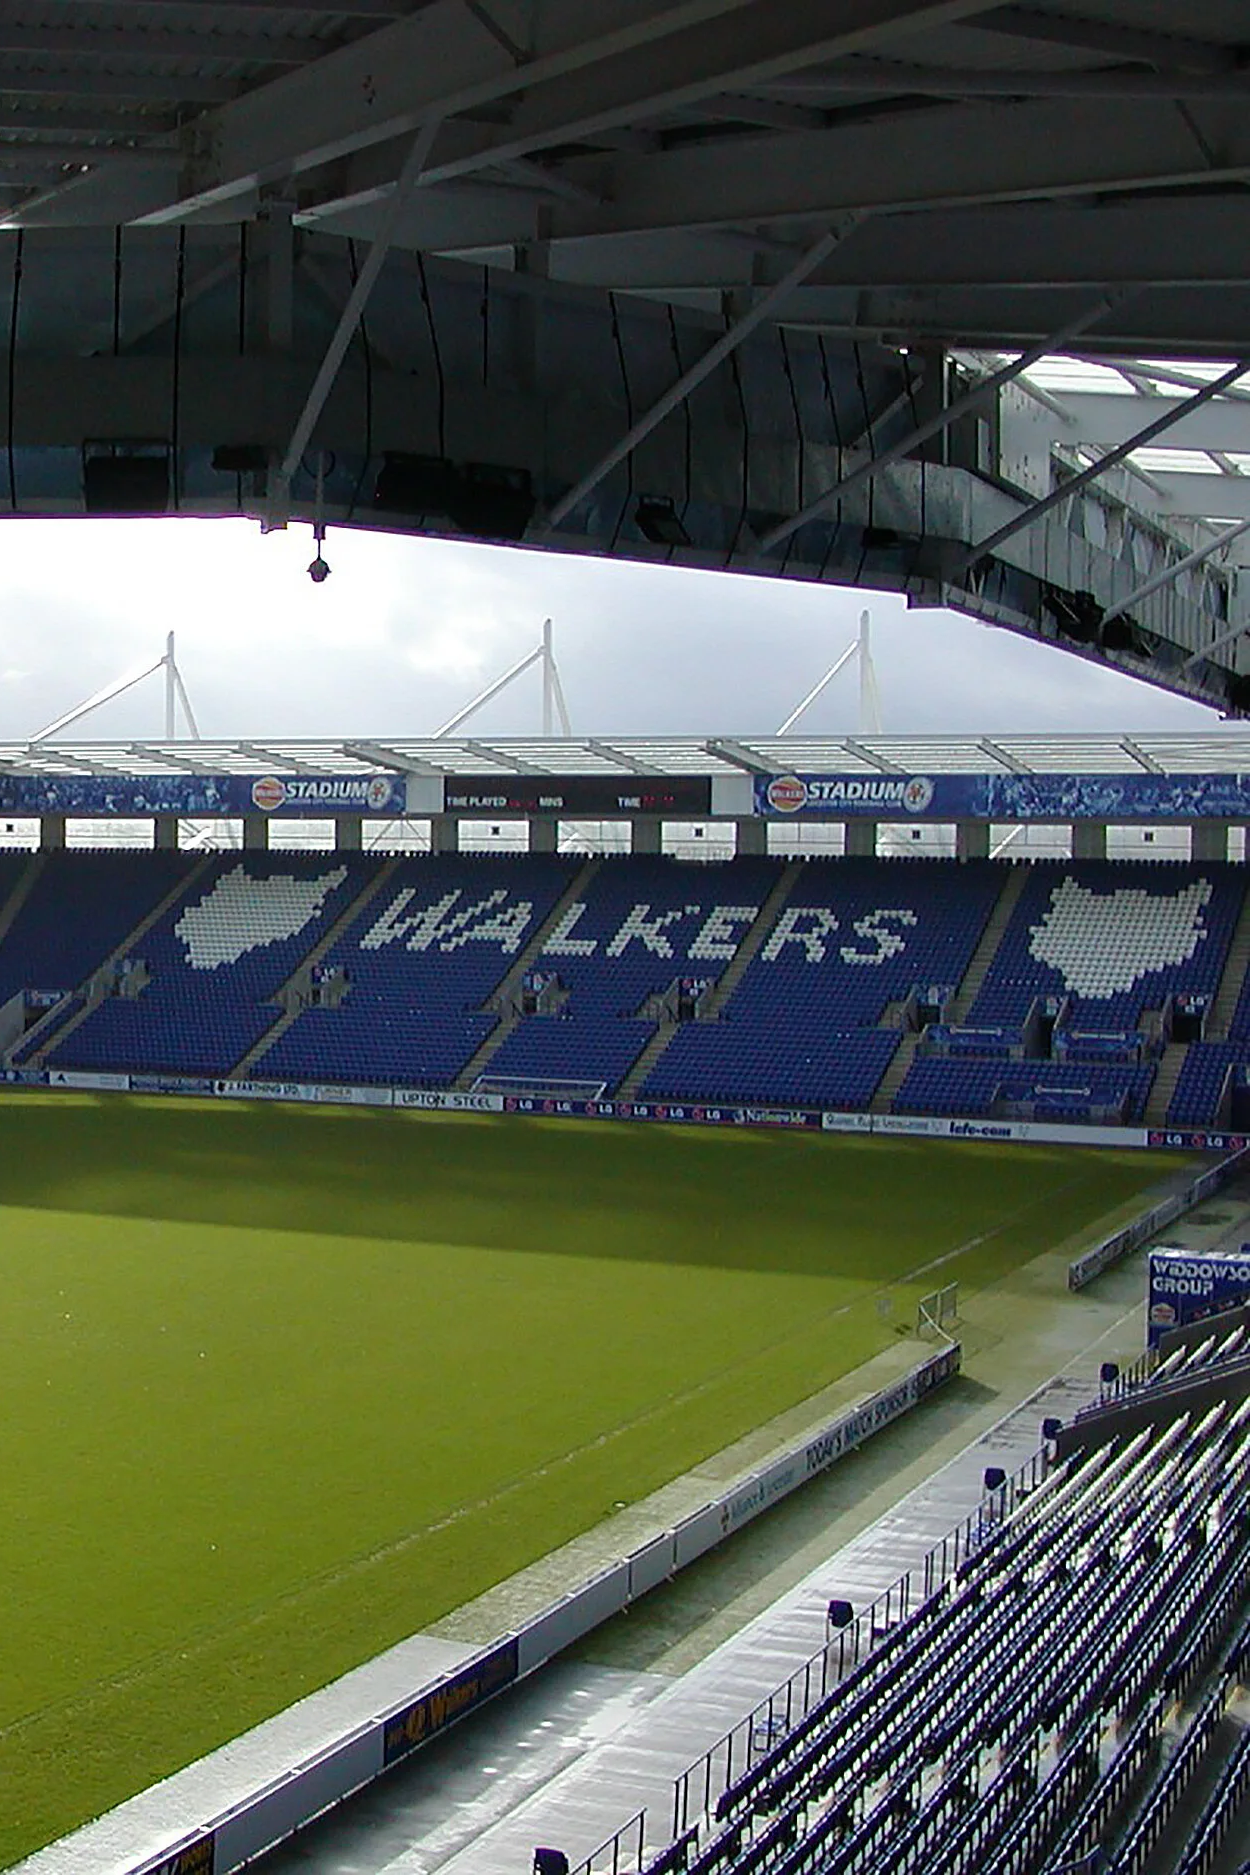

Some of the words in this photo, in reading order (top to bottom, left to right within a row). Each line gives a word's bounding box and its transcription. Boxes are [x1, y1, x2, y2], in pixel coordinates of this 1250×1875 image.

[286, 781, 369, 798] STADIUM
[808, 781, 905, 800] STADIUM
[359, 887, 918, 965] WALKERS
[402, 1092, 446, 1107] UPTON
[453, 1095, 492, 1109] STEEL
[519, 1100, 533, 1110] LG
[557, 1102, 571, 1112] LG
[599, 1104, 613, 1113] LG
[634, 1106, 648, 1116] LG
[670, 1108, 684, 1118] LG
[707, 1110, 721, 1121] LG
[1166, 1133, 1182, 1145] LG
[1207, 1135, 1223, 1147] LG
[1152, 1276, 1214, 1296] GROUP
